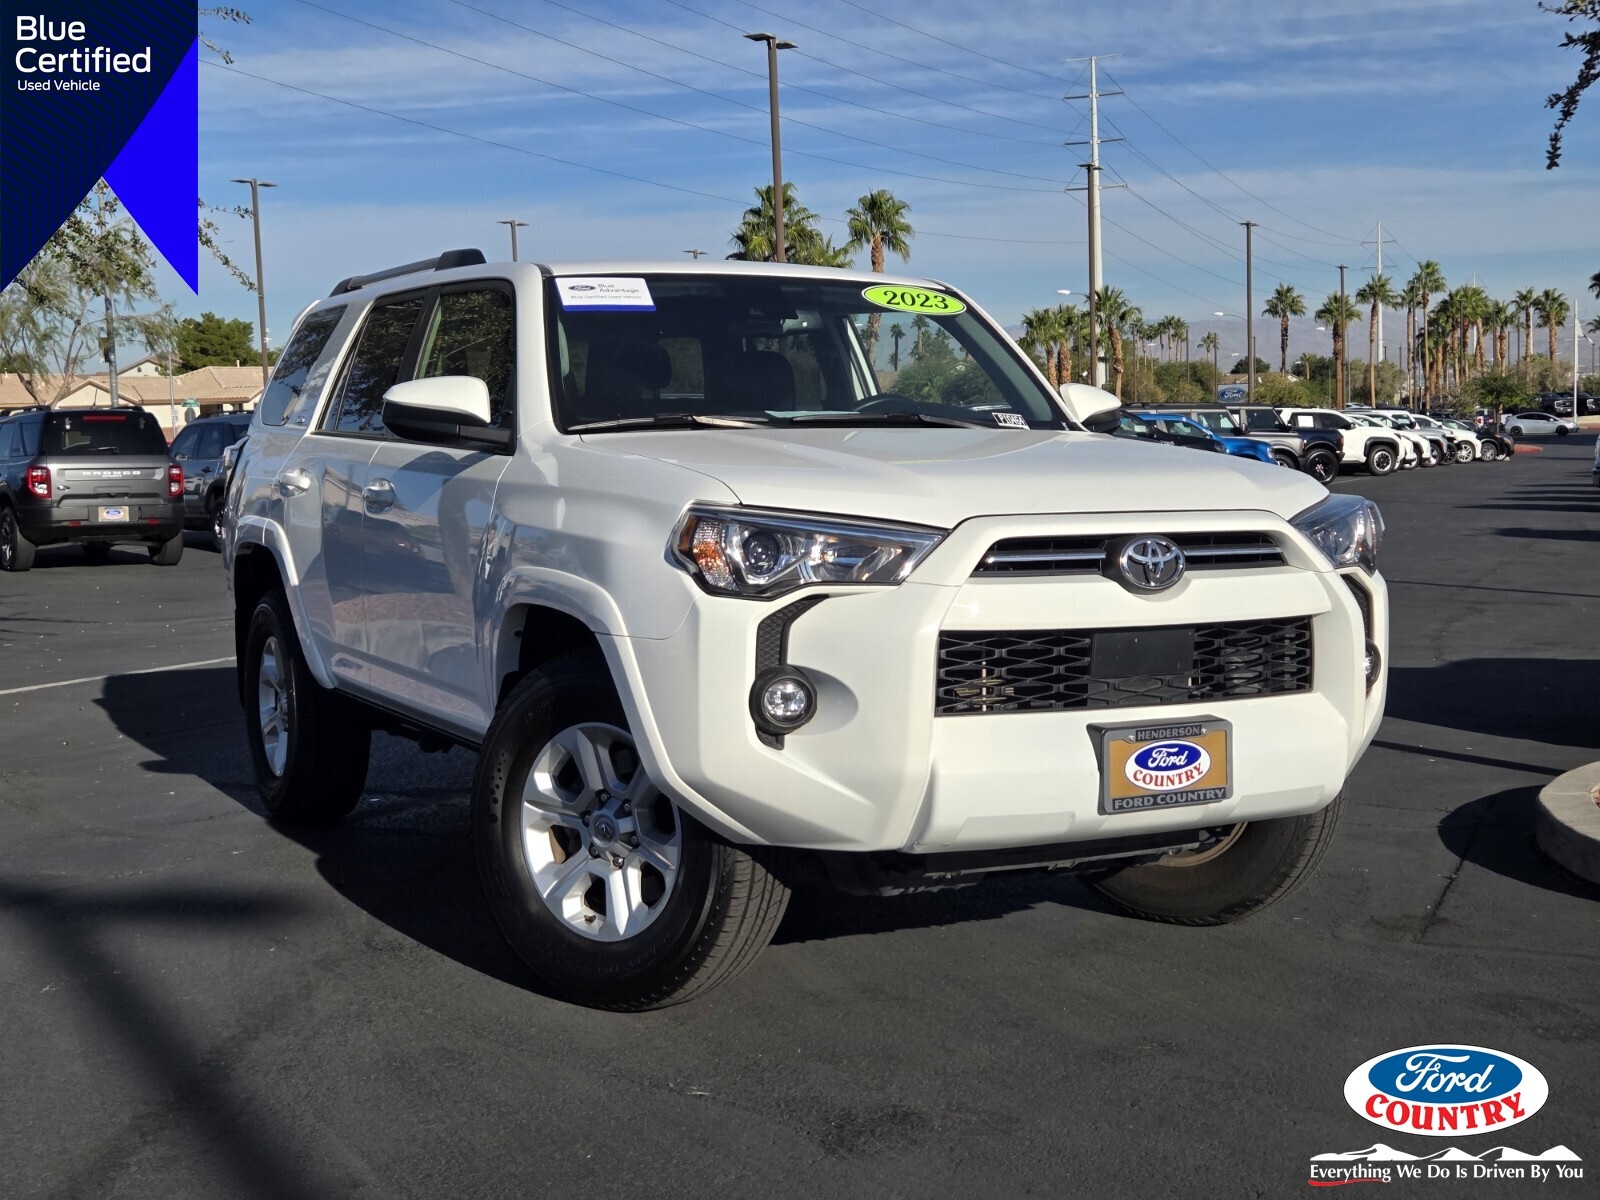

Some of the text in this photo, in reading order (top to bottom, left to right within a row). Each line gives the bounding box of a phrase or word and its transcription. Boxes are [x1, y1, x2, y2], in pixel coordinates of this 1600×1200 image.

[883, 290, 949, 310] 2023
[1137, 725, 1201, 741] HENDERSON
[1147, 747, 1189, 768] Ford
[1132, 762, 1204, 787] COUNTRY
[1114, 788, 1226, 810] FORD COUNTRY
